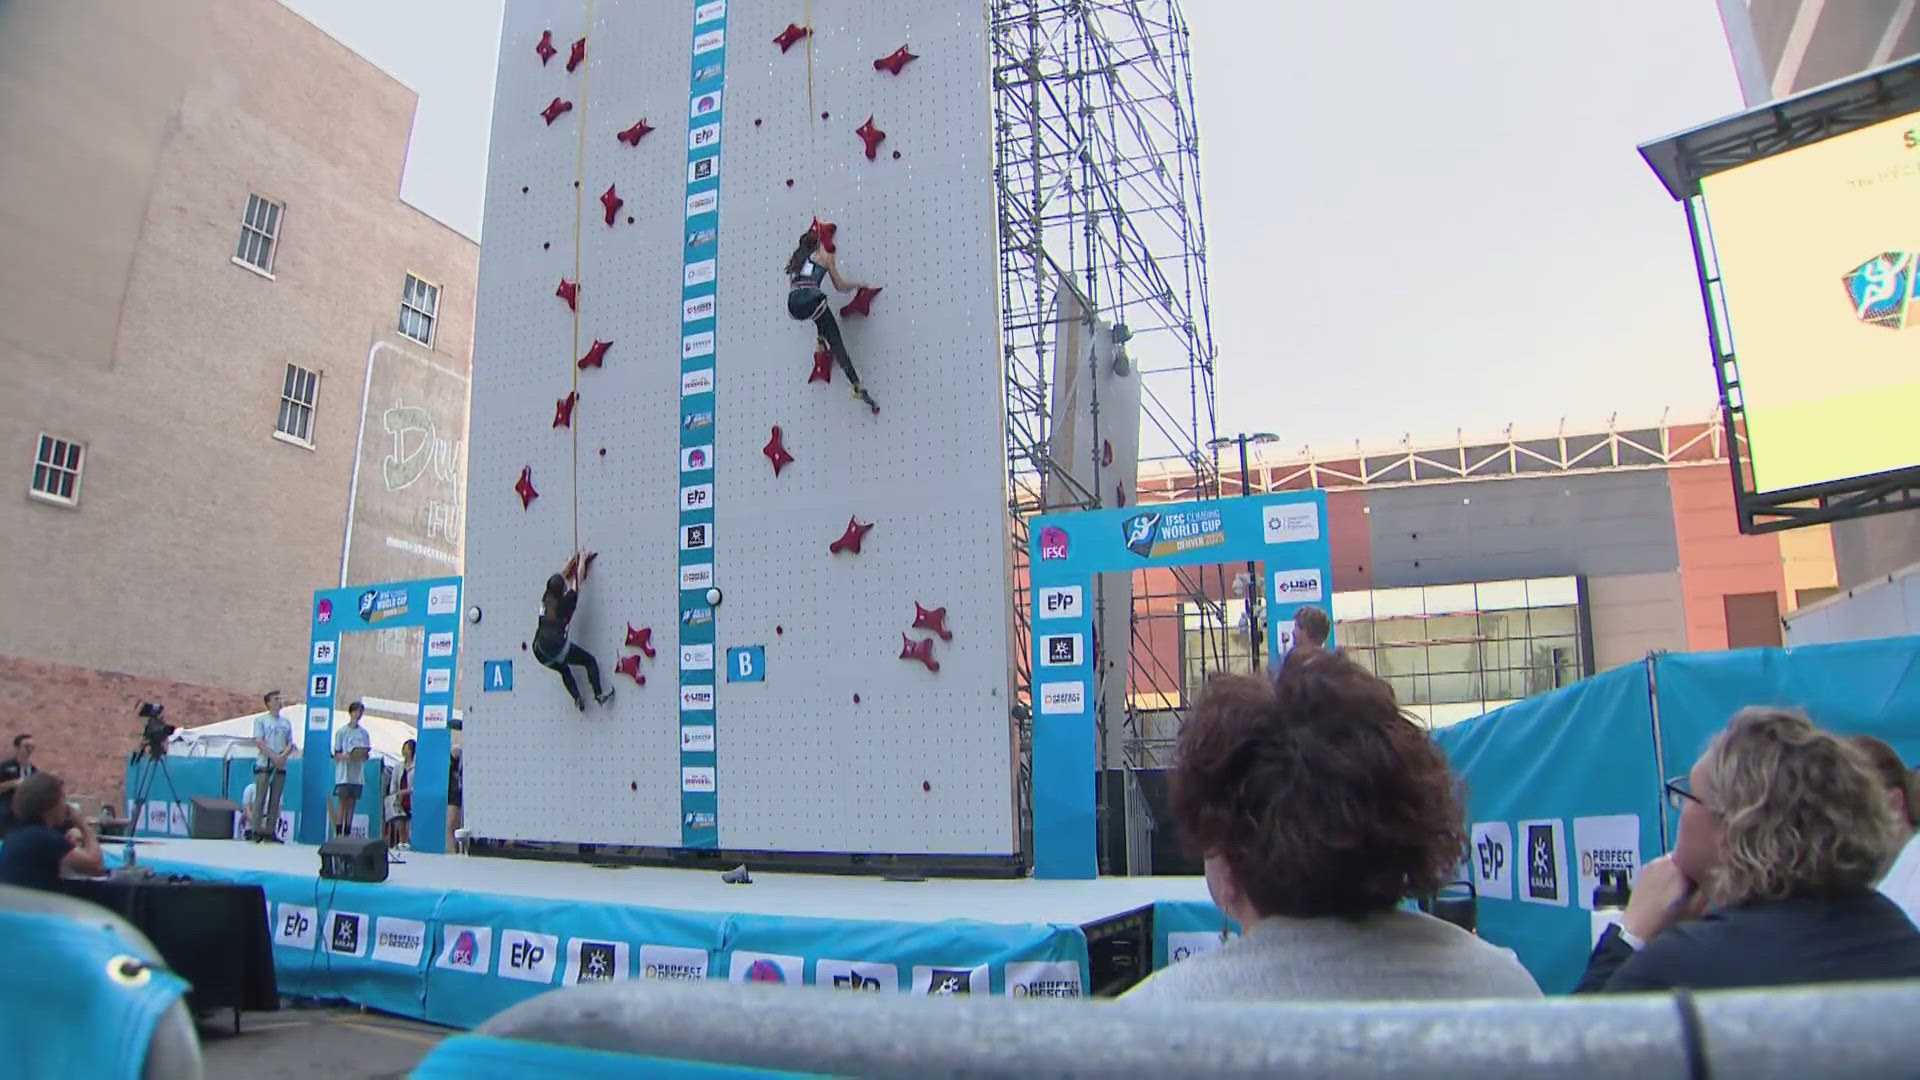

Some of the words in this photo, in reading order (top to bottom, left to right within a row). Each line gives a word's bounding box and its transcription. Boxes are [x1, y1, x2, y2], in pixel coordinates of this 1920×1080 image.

[1165, 513, 1185, 526] IFSC
[1161, 522, 1200, 540] WORLD
[1201, 519, 1222, 533] CUP
[1043, 545, 1066, 560] IFSC
[739, 652, 753, 676] B
[494, 665, 504, 688] A
[1593, 849, 1633, 862] PERFECT
[658, 963, 703, 975] PERFECT
